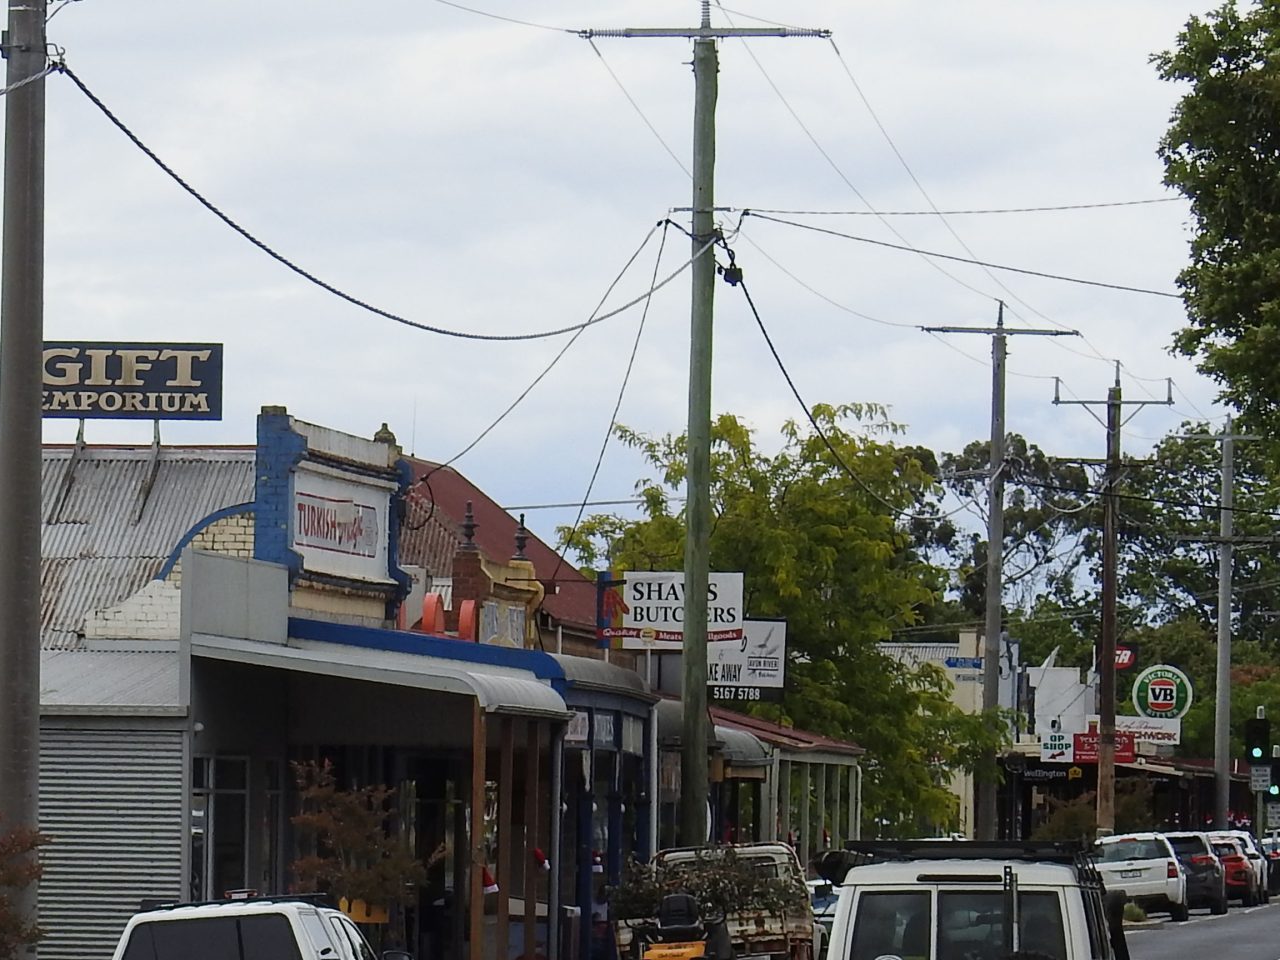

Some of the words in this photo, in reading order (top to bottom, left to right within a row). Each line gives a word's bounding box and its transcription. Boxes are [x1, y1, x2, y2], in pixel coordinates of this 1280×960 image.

[42, 347, 212, 387] GIFT
[297, 503, 337, 541] TURKISH
[720, 664, 743, 682] AWAY
[1143, 670, 1181, 684] VICTORIA
[713, 687, 735, 699] 5167
[738, 688, 761, 700] 5788
[1150, 687, 1175, 702] VB
[1049, 735, 1065, 743] OP
[1042, 742, 1072, 751] SHOP
[1023, 769, 1067, 779] Wellington
